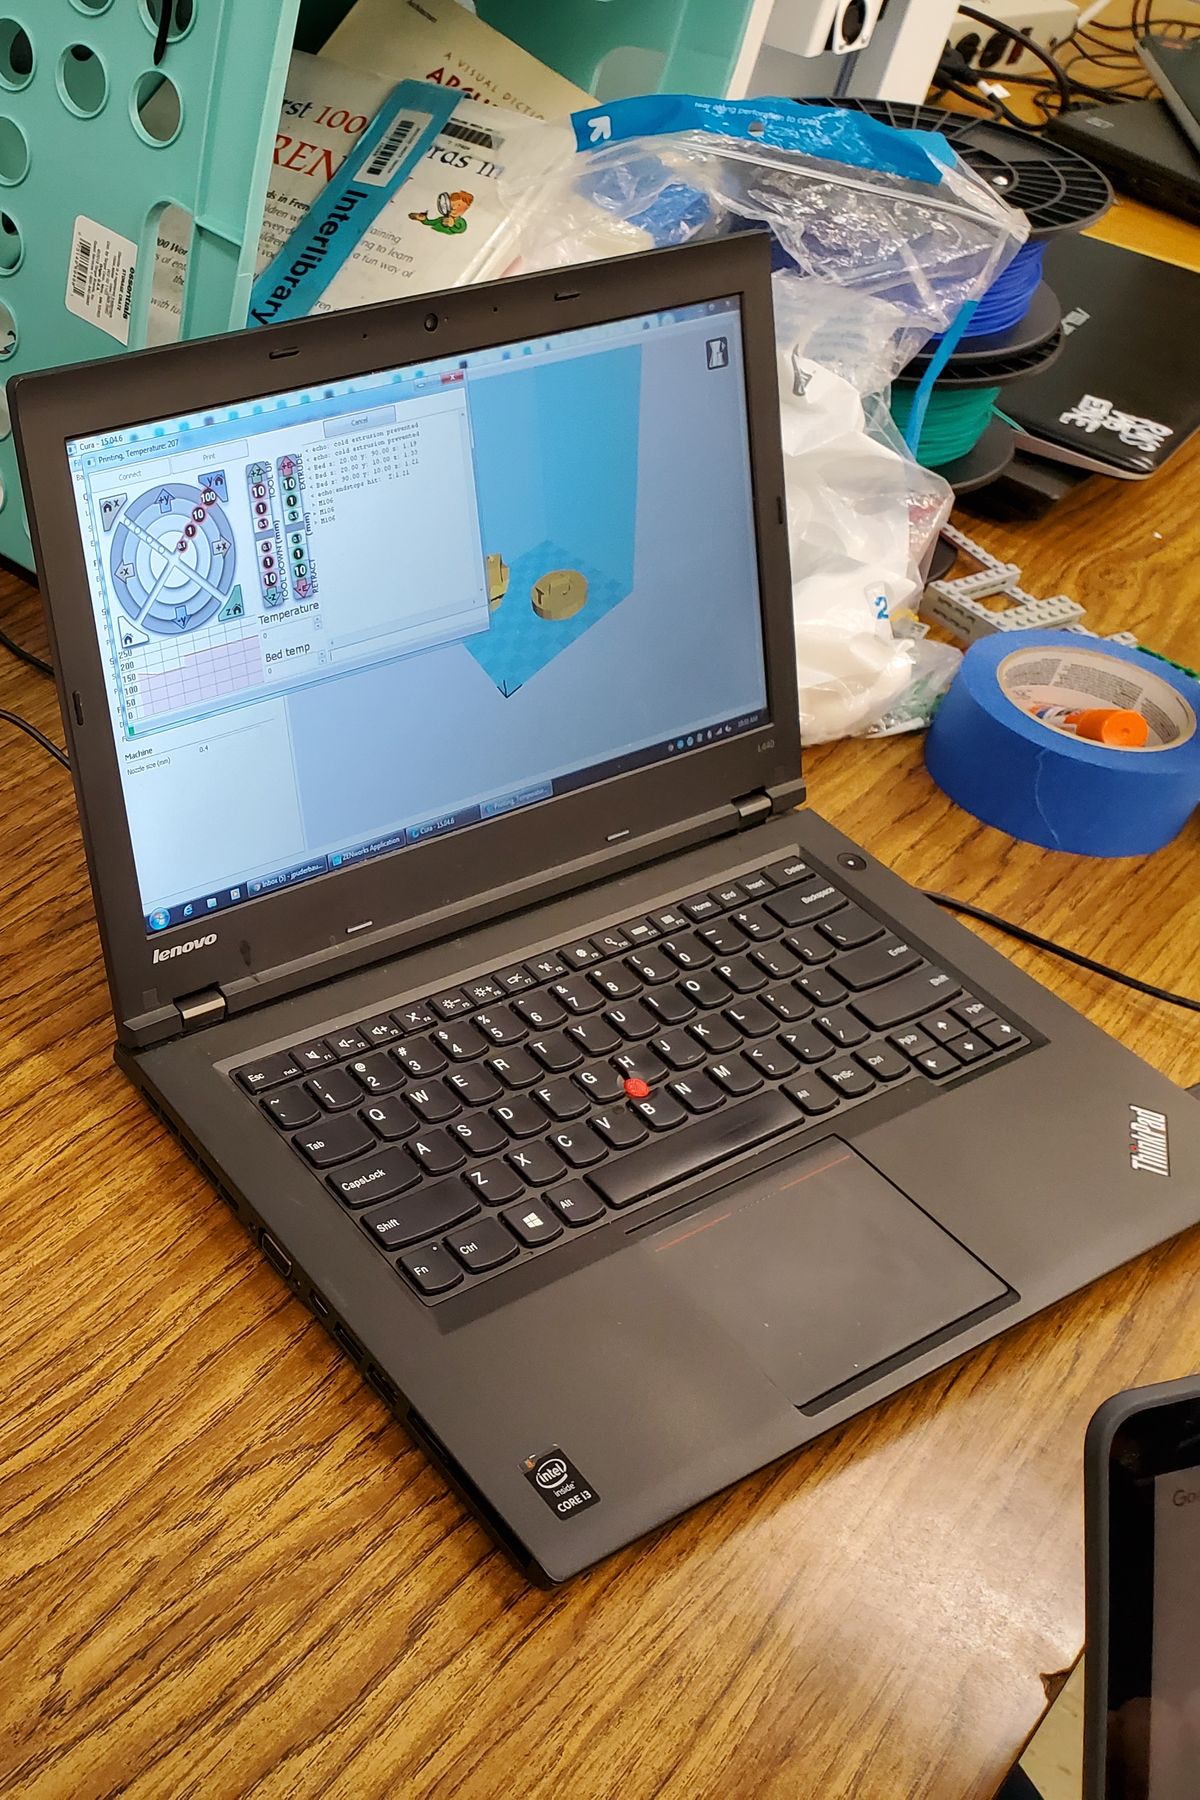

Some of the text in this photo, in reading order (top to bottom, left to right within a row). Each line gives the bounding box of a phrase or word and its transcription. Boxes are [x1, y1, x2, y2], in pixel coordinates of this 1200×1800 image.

[444, 51, 452, 61] A
[458, 61, 498, 94] VISUAL
[314, 106, 368, 134] 100
[251, 190, 368, 324] Interlibrary
[80, 442, 94, 450] Cura
[168, 439, 179, 447] 207
[334, 439, 348, 448] cold
[203, 453, 215, 461] Print
[119, 471, 142, 481] Connect
[296, 453, 306, 490] EXTRUDE
[283, 479, 295, 488] 10
[252, 486, 264, 496] 10
[201, 492, 215, 502] 100
[193, 510, 204, 519] 10
[304, 512, 313, 536] (mm)
[295, 565, 305, 575] 10
[264, 574, 276, 584] 10
[309, 560, 319, 594] RETRACT
[258, 602, 319, 624] Temperature
[875, 596, 888, 620] 2
[266, 644, 310, 662] Bed temp
[121, 662, 134, 671] 200
[123, 674, 136, 683] 150
[125, 686, 138, 695] 100
[127, 699, 136, 707] 50
[125, 748, 152, 760] Machine
[157, 758, 170, 768] (mm)
[420, 826, 432, 835] Cura
[369, 837, 400, 854] Application
[262, 878, 277, 888] Inbox
[721, 891, 737, 900] End
[692, 901, 712, 912] Home
[152, 933, 218, 964] lenovo
[644, 968, 655, 976] 9
[720, 966, 732, 977] P
[606, 982, 619, 991] 8
[686, 980, 700, 991] O
[568, 997, 578, 1006] 7
[530, 1012, 542, 1021] 6
[610, 1011, 625, 1021] U
[730, 1010, 745, 1020] L
[491, 1028, 503, 1037] 5
[572, 1026, 586, 1037] Y
[694, 1024, 710, 1035] K
[452, 1044, 462, 1053] 4
[534, 1042, 547, 1054] T
[660, 1040, 671, 1051] J
[409, 1061, 421, 1070] 3
[493, 1059, 510, 1070] R
[618, 1056, 635, 1068] H
[713, 1065, 731, 1078] M
[248, 1073, 264, 1082] Esc
[368, 1077, 380, 1086] 2
[452, 1075, 468, 1087] E
[581, 1072, 597, 1084] G
[675, 1083, 692, 1094] N
[325, 1093, 335, 1103] 1
[410, 1090, 429, 1103] W
[540, 1089, 551, 1101] F
[498, 1108, 513, 1119] D
[640, 1103, 656, 1114] B
[369, 1109, 386, 1120] Q
[596, 1117, 611, 1129] V
[457, 1125, 472, 1136] S
[306, 1141, 324, 1151] Tab
[558, 1135, 572, 1147] C
[1129, 1105, 1169, 1176] ThinkPad
[416, 1143, 431, 1155] A
[514, 1153, 531, 1166] X
[342, 1169, 386, 1191] CapsLock
[471, 1172, 488, 1185] Z
[560, 1199, 574, 1209] Alt
[377, 1219, 400, 1233] Shift
[460, 1243, 478, 1255] Ctrl
[414, 1266, 428, 1276] Fn
[539, 1463, 565, 1482] intel
[553, 1481, 576, 1498] inside
[557, 1495, 583, 1512] CORE
